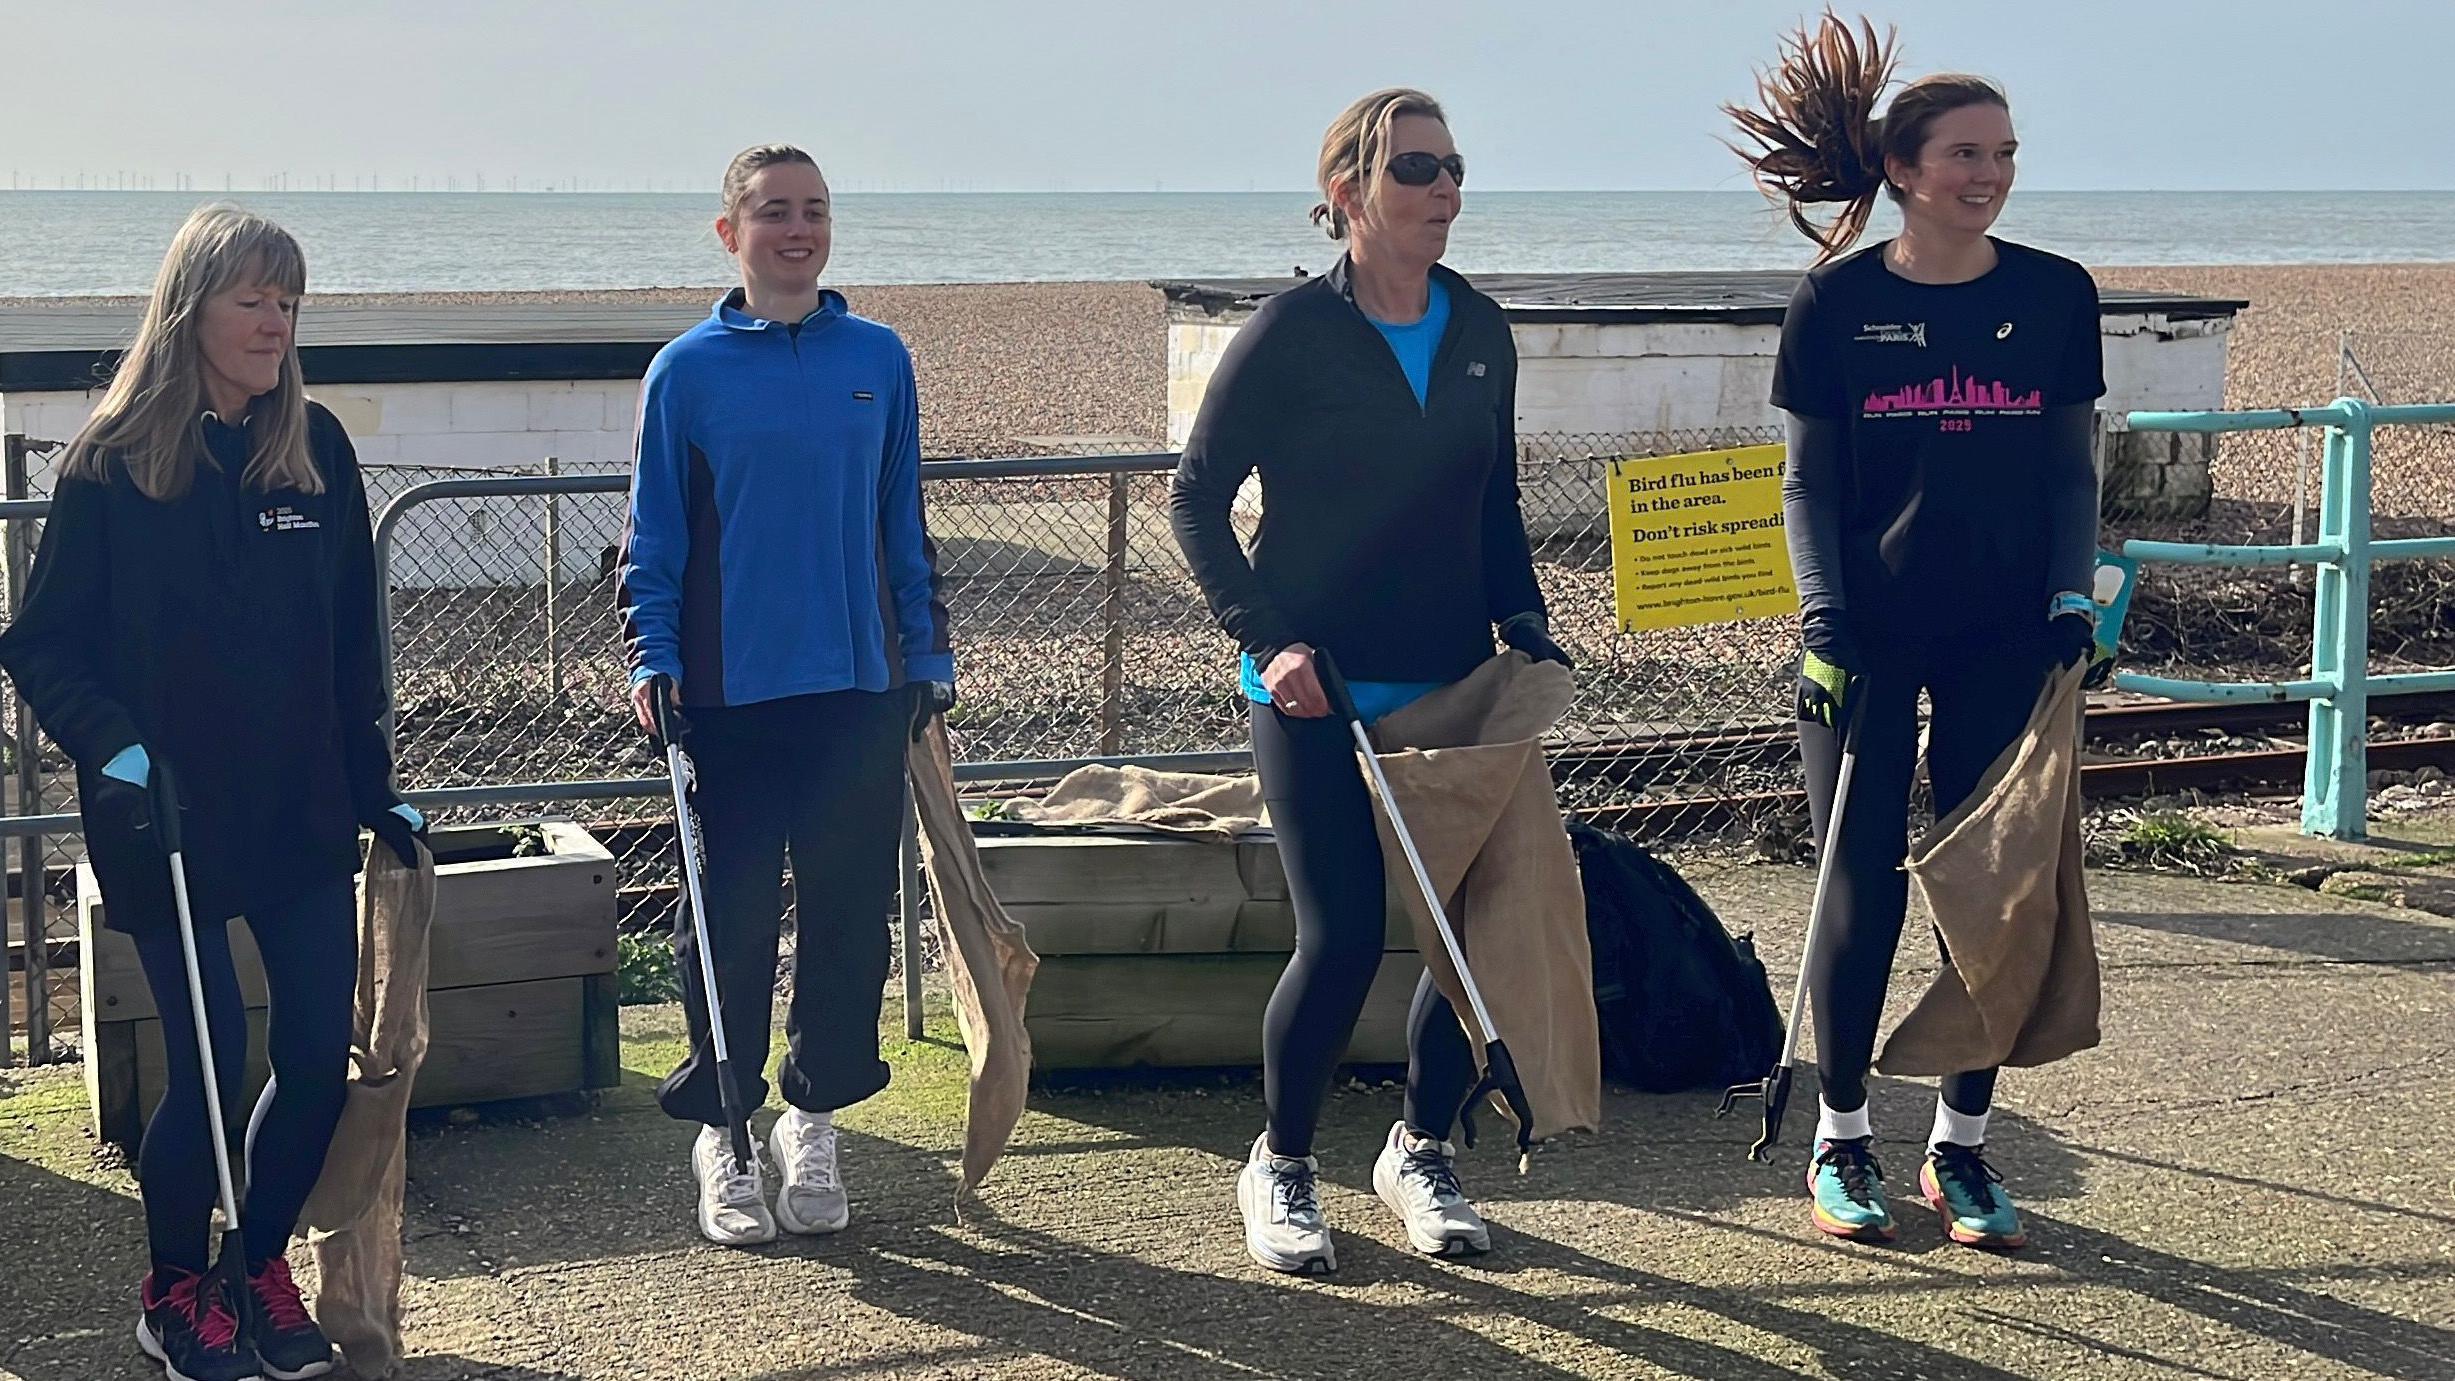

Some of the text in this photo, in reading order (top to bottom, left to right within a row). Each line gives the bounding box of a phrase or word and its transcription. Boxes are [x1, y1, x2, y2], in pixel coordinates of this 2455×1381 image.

[1628, 476, 1667, 493] Bird
[1670, 473, 1697, 489] flu
[1699, 471, 1730, 484] has
[1732, 466, 1774, 481] been
[1631, 494, 1726, 514] in the area.
[1633, 512, 1785, 543] Don’t risk spreadi
[1666, 551, 1688, 559] touch
[1689, 548, 1708, 556] dead
[1640, 569, 1660, 577] Keep
[1641, 583, 1667, 591] Report
[1684, 578, 1703, 586] dead
[1757, 569, 1773, 577] find
